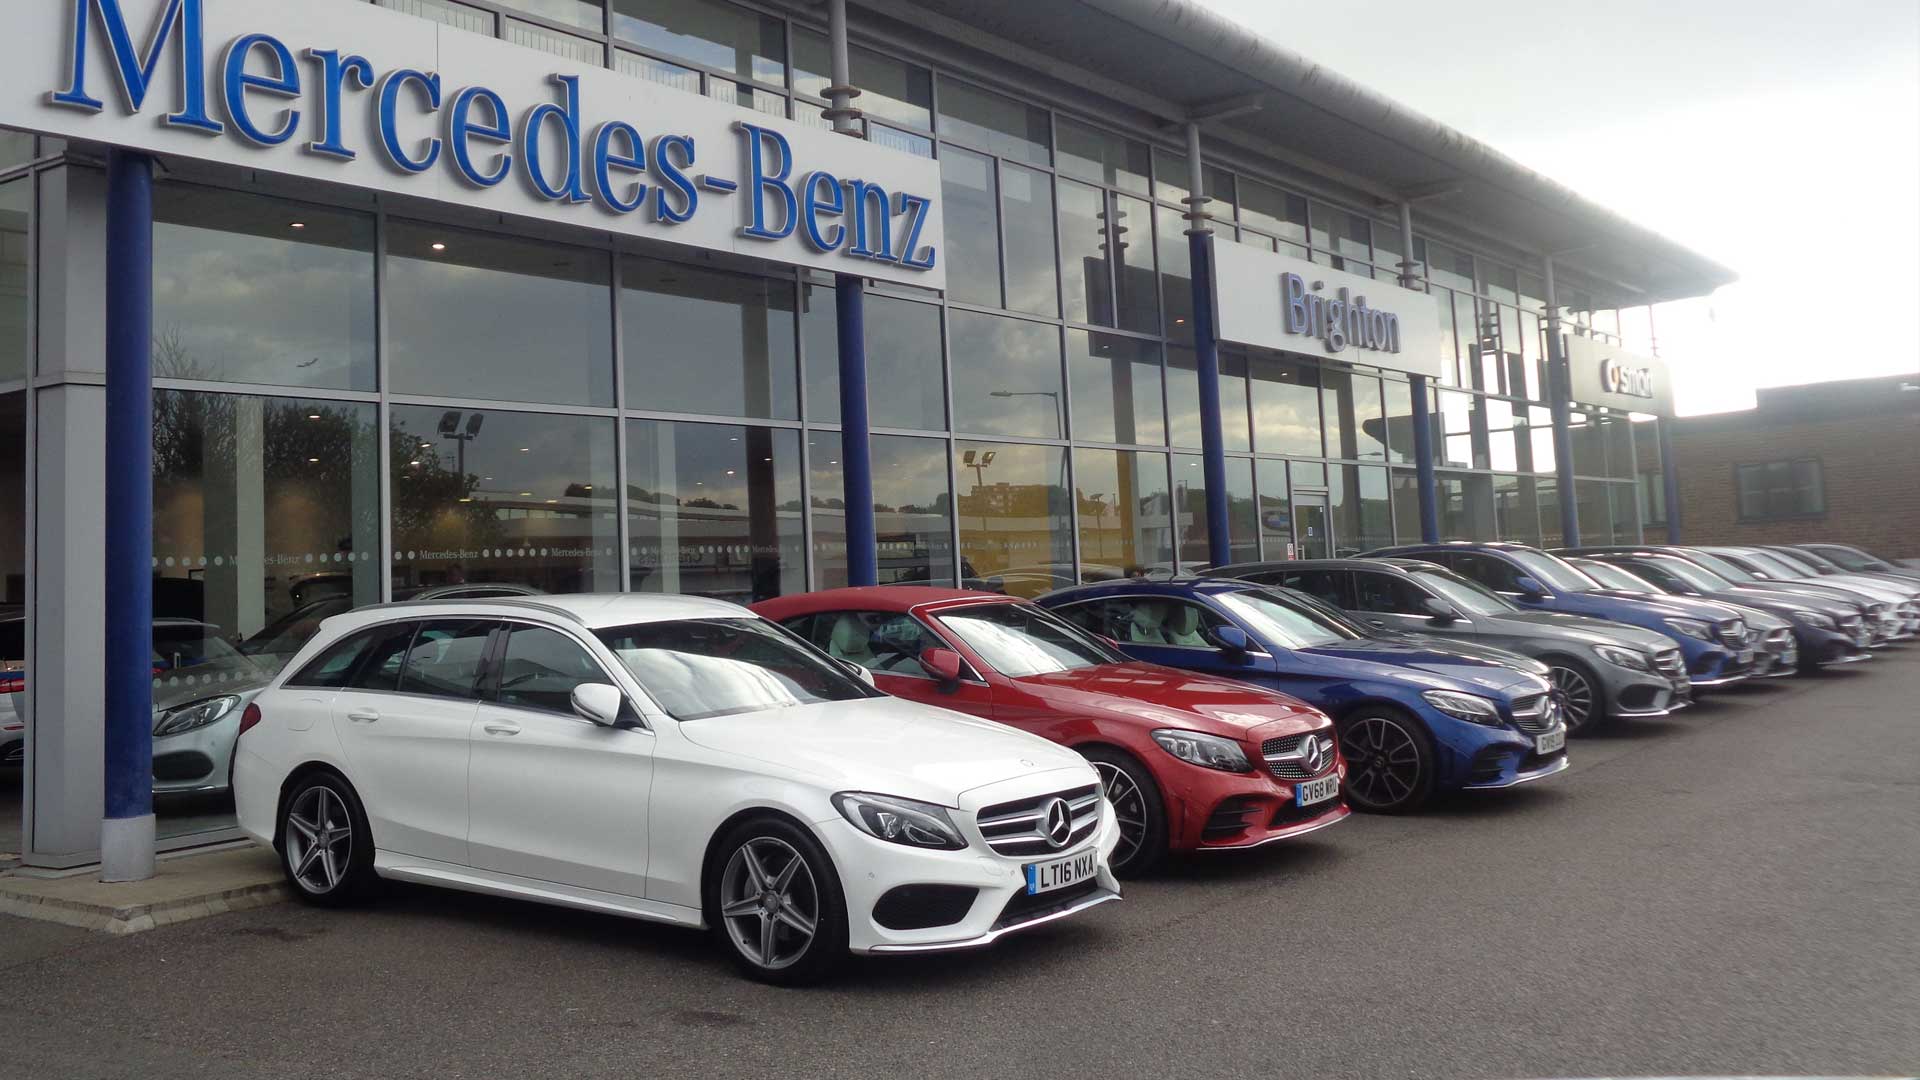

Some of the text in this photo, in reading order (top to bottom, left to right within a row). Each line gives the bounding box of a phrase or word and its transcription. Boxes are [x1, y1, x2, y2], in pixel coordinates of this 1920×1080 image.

[50, 0, 936, 271] Mercedes-Benz
[1281, 272, 1400, 352] Brighton
[420, 549, 479, 560] Mercedes-Benz
[1303, 781, 1324, 802] GV68
[1041, 853, 1094, 888] LT16 NXA
